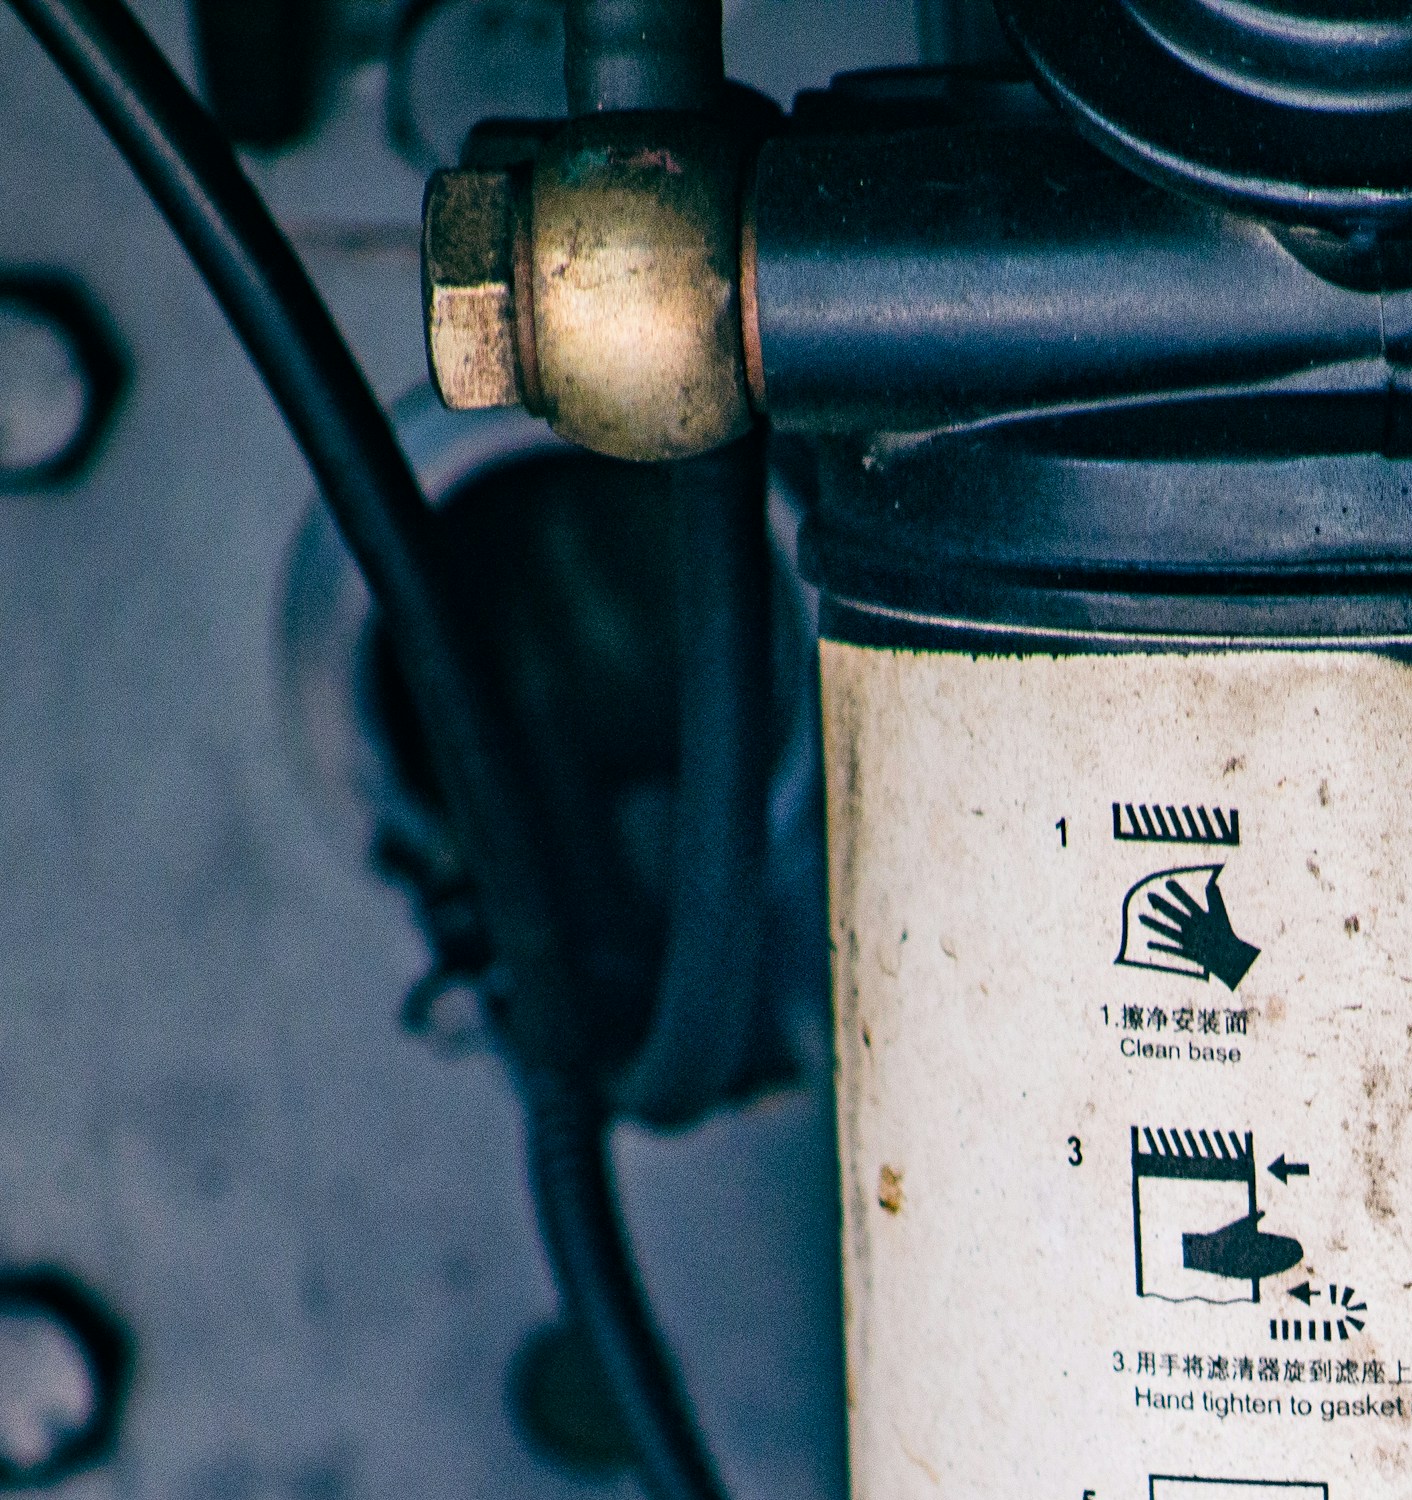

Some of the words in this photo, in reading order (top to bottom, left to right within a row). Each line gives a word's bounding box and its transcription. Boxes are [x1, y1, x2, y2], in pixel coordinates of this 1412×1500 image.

[1055, 817, 1068, 847] 1
[1120, 1037, 1180, 1060] Clean
[1189, 1041, 1241, 1063] base
[1068, 1135, 1083, 1167] 3
[1135, 1387, 1194, 1411] Hand
[1203, 1391, 1281, 1418] tighten
[1291, 1395, 1312, 1416] to
[1321, 1396, 1403, 1421] gasket
